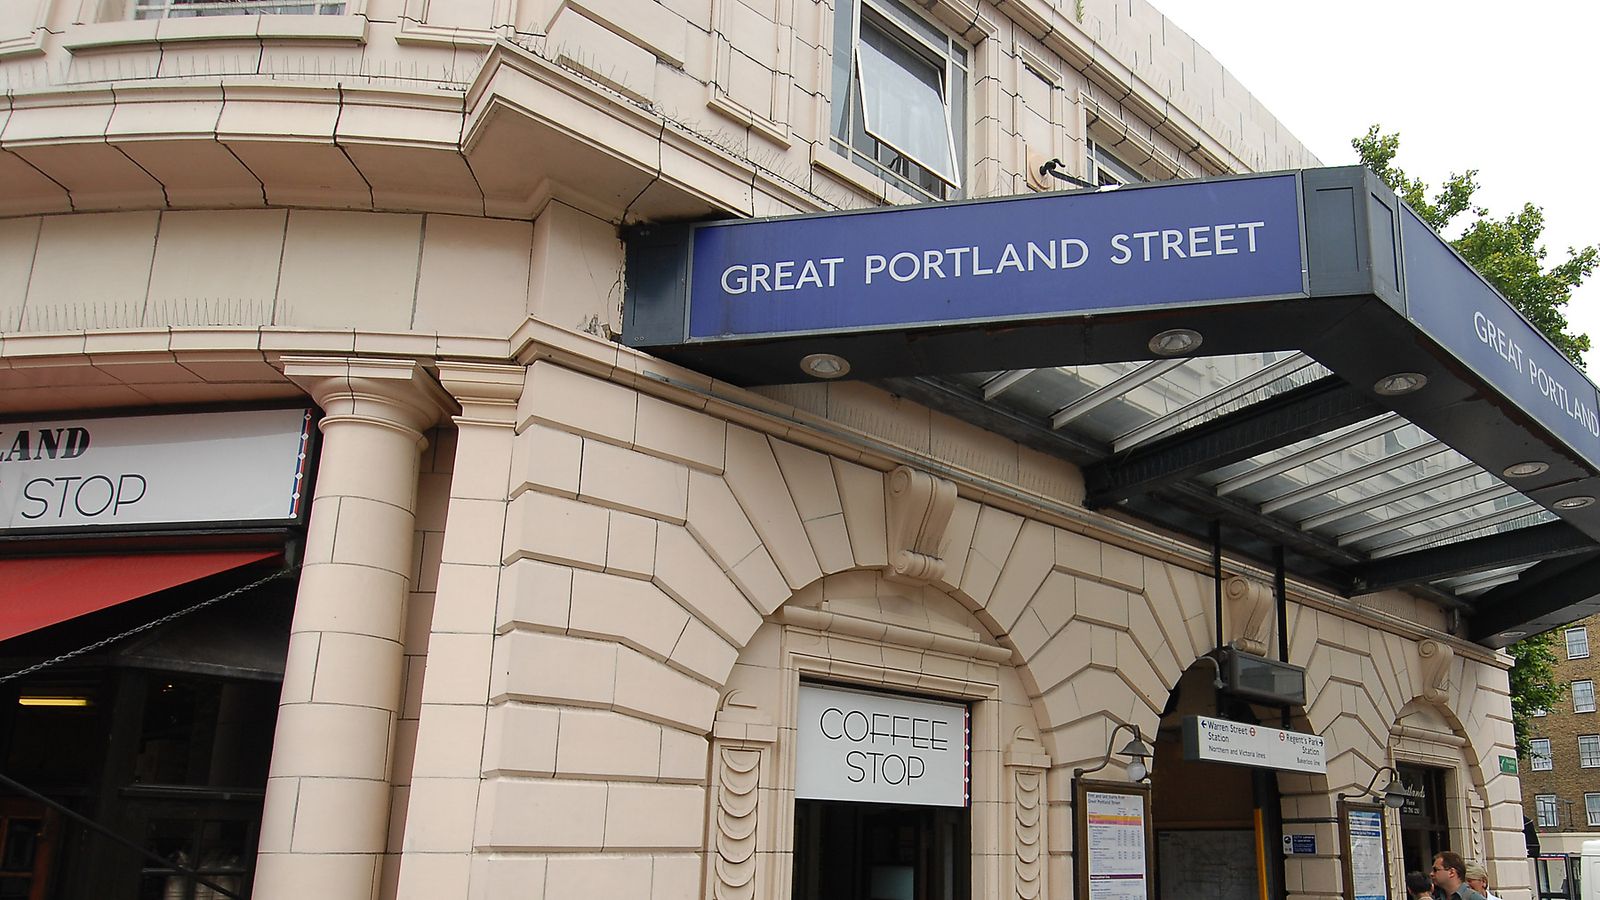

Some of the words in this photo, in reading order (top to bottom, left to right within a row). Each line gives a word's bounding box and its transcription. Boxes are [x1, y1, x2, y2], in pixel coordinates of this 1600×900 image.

[720, 257, 845, 296] GREAT
[865, 238, 1089, 285] PORTLAND
[1110, 221, 1265, 265] STREET
[1474, 311, 1522, 374] GREAT
[1529, 358, 1600, 437] PORTLAND
[0, 427, 90, 461] AND
[21, 474, 147, 519] STOP
[820, 708, 948, 751] COFFEE
[1207, 720, 1229, 732] Warren
[1230, 724, 1248, 736] Street
[1208, 731, 1230, 743] Station
[1286, 733, 1308, 745] Regent's
[1309, 737, 1319, 747] Park
[1208, 745, 1229, 754] Northern
[1230, 748, 1238, 756] and
[1238, 749, 1256, 758] Victoria
[1302, 745, 1320, 756] Station
[846, 750, 925, 786] STOP
